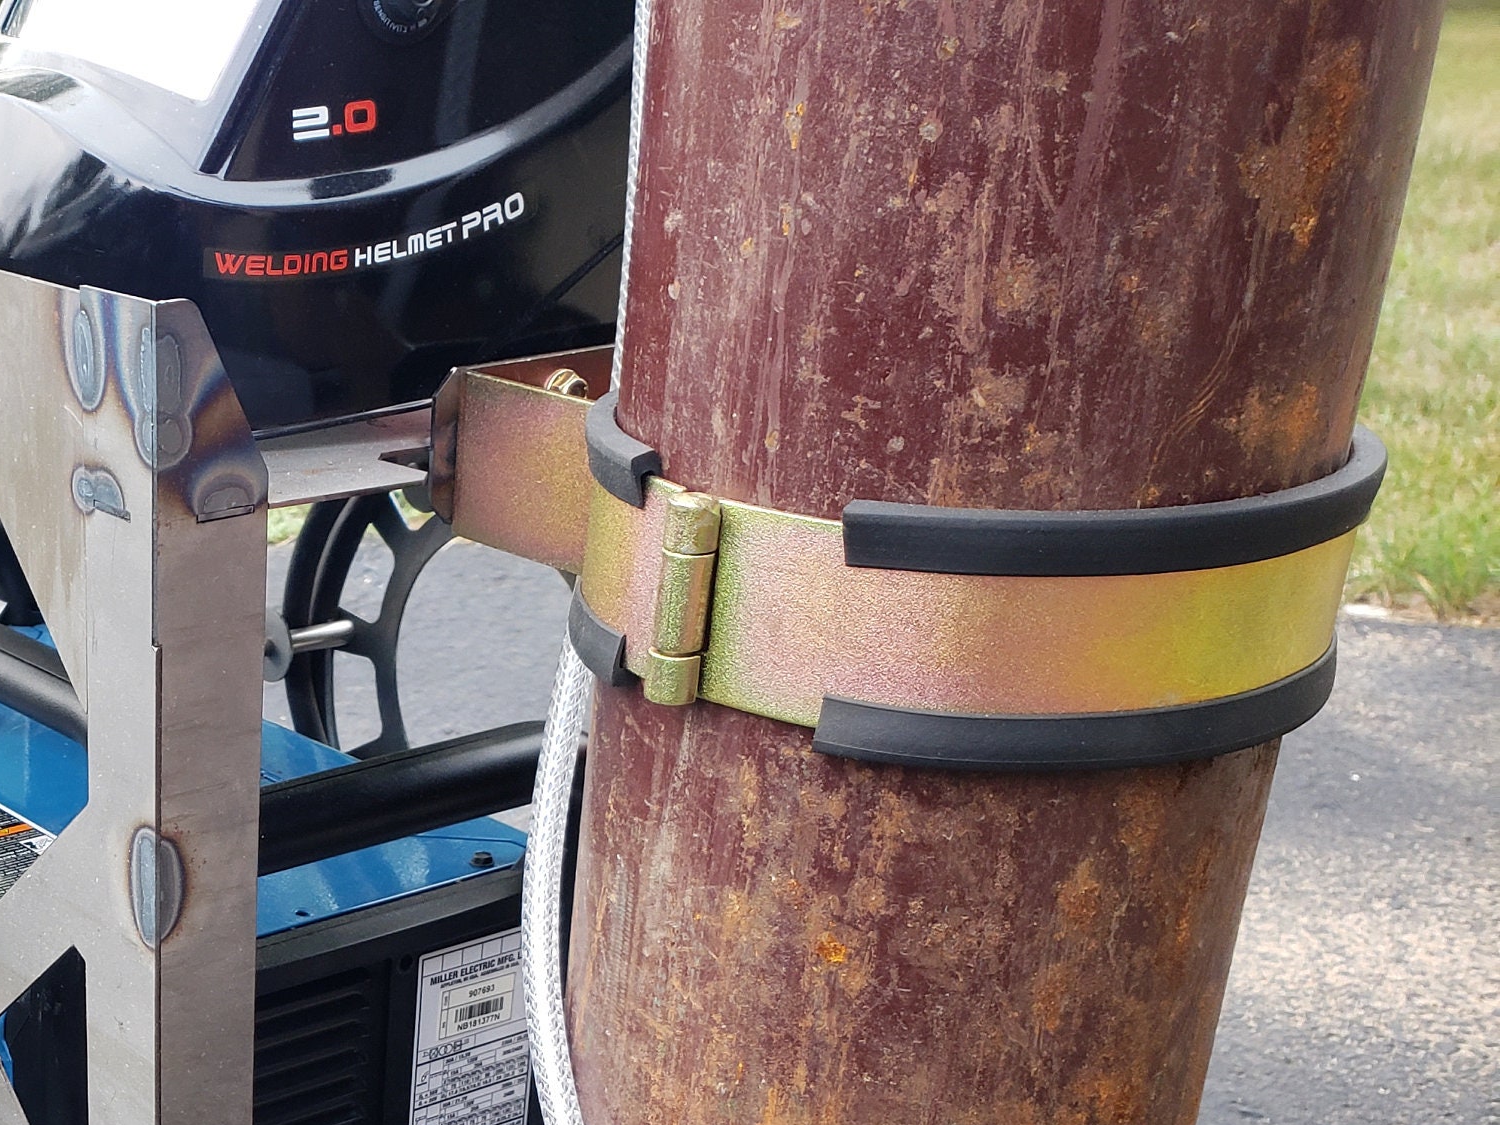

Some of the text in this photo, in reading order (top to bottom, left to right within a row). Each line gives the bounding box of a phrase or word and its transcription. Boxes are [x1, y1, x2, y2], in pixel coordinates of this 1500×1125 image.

[292, 99, 378, 141] 2.0
[214, 191, 524, 276] WELDING HELMET PRO
[430, 971, 458, 985] MILLER
[461, 960, 495, 976] ELECTRIC
[468, 983, 496, 998] 907693
[456, 1012, 500, 1031] NB181377N
